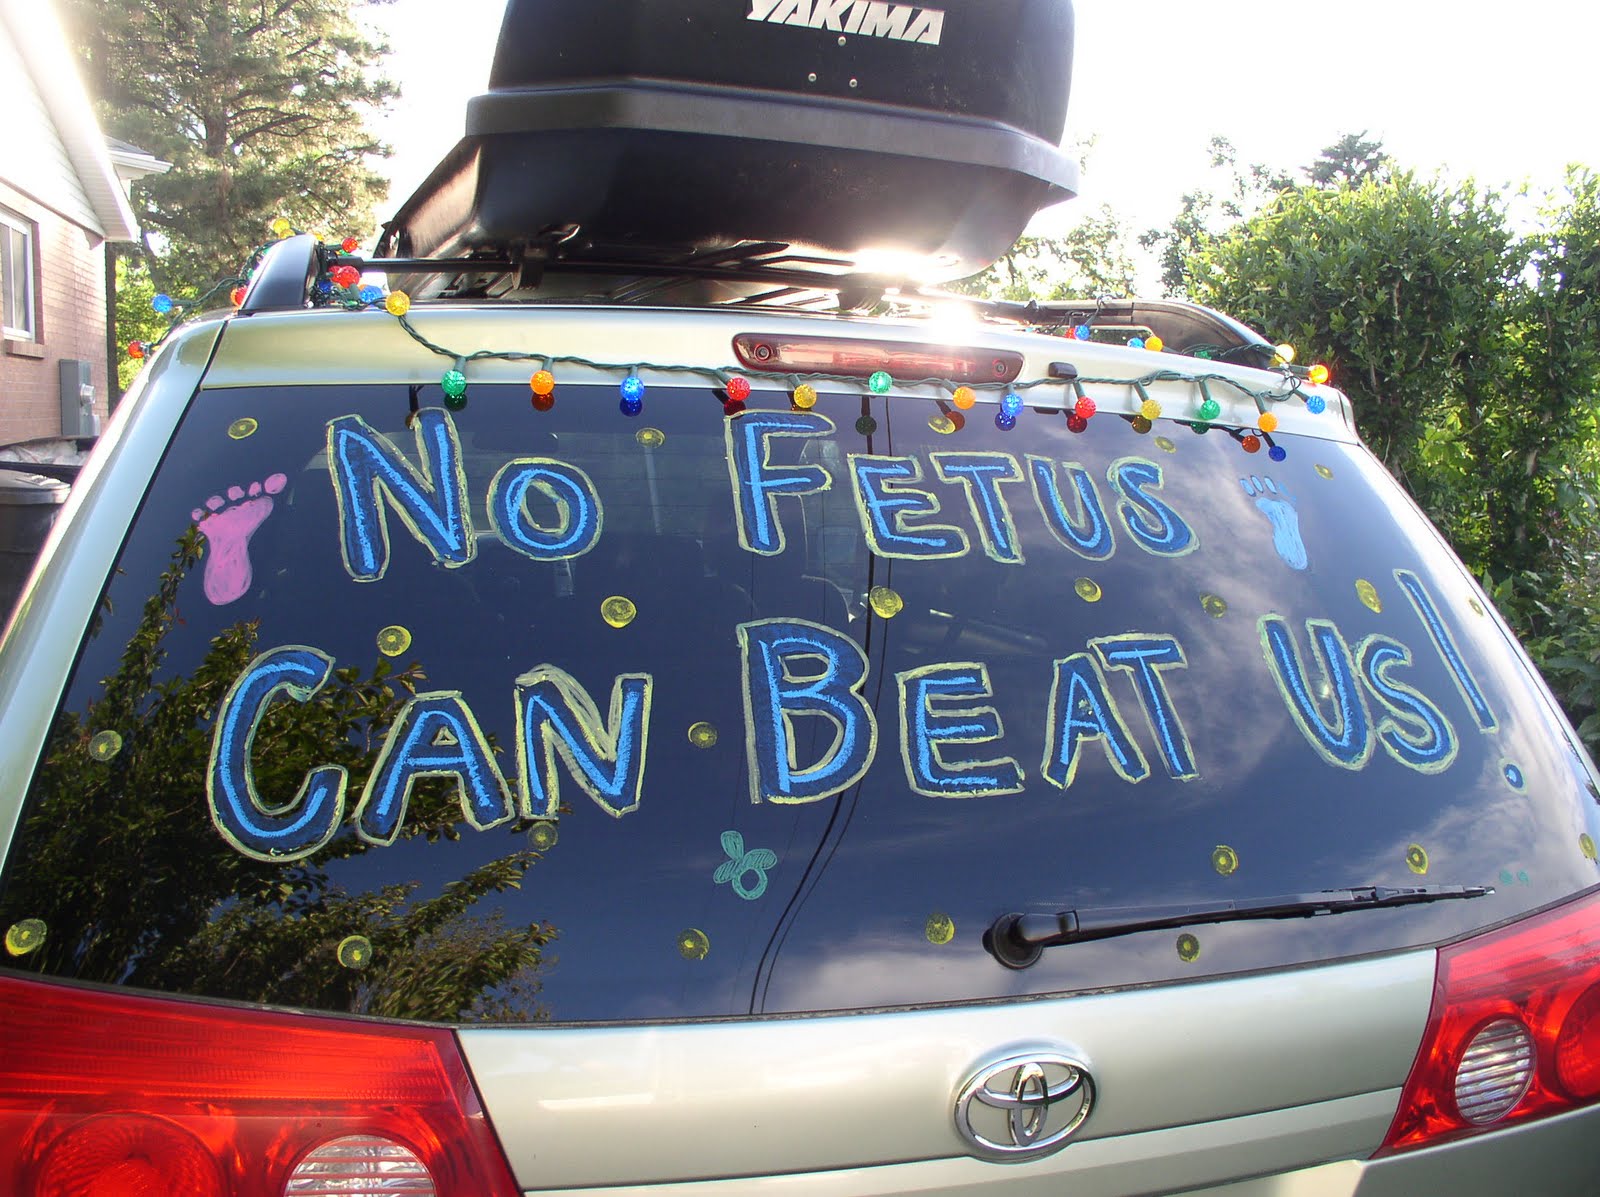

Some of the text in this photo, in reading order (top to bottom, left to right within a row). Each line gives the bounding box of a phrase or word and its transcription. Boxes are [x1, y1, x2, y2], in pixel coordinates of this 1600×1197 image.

[747, 0, 945, 45] YAKIMA
[724, 409, 1198, 564] FETUS
[207, 645, 652, 863] CAN
[736, 617, 1199, 804] BEAT
